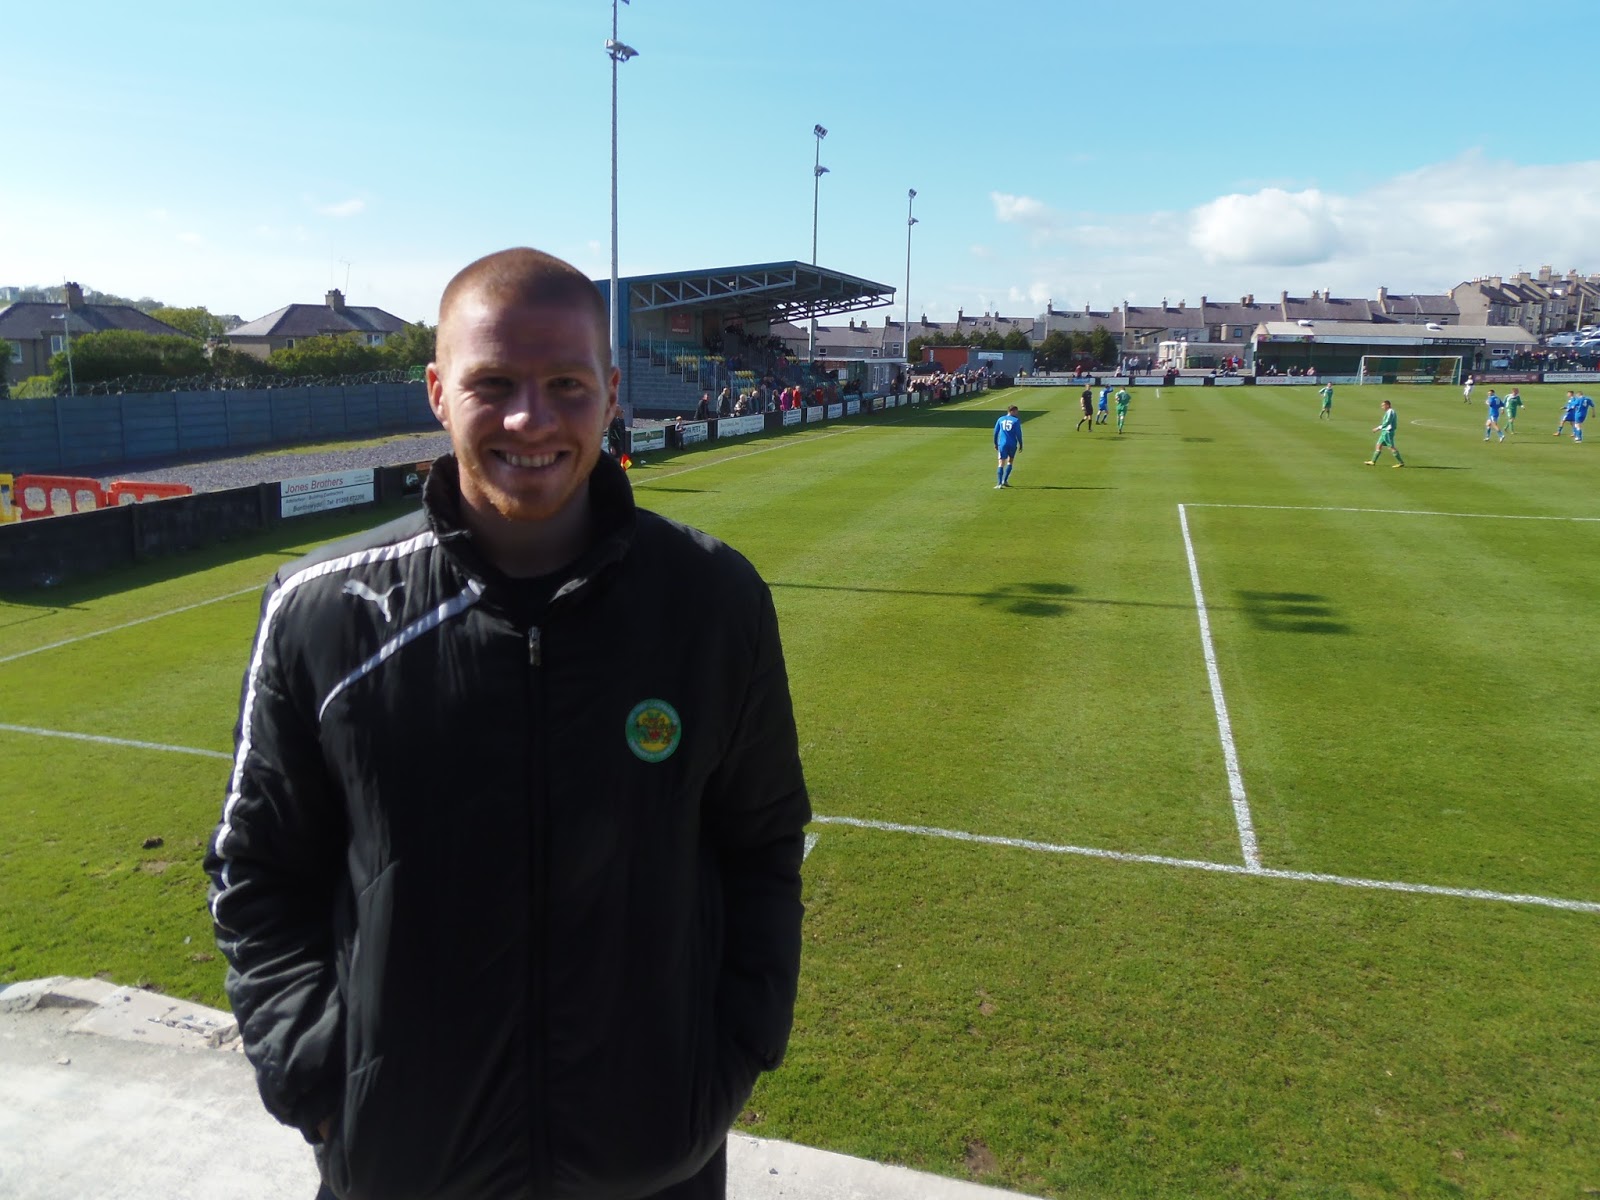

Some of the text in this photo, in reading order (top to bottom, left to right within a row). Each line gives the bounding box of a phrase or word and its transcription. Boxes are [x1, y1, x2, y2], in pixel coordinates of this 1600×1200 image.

[1001, 419, 1013, 431] 15
[285, 483, 309, 494] Jones
[311, 478, 343, 489] Brothers
